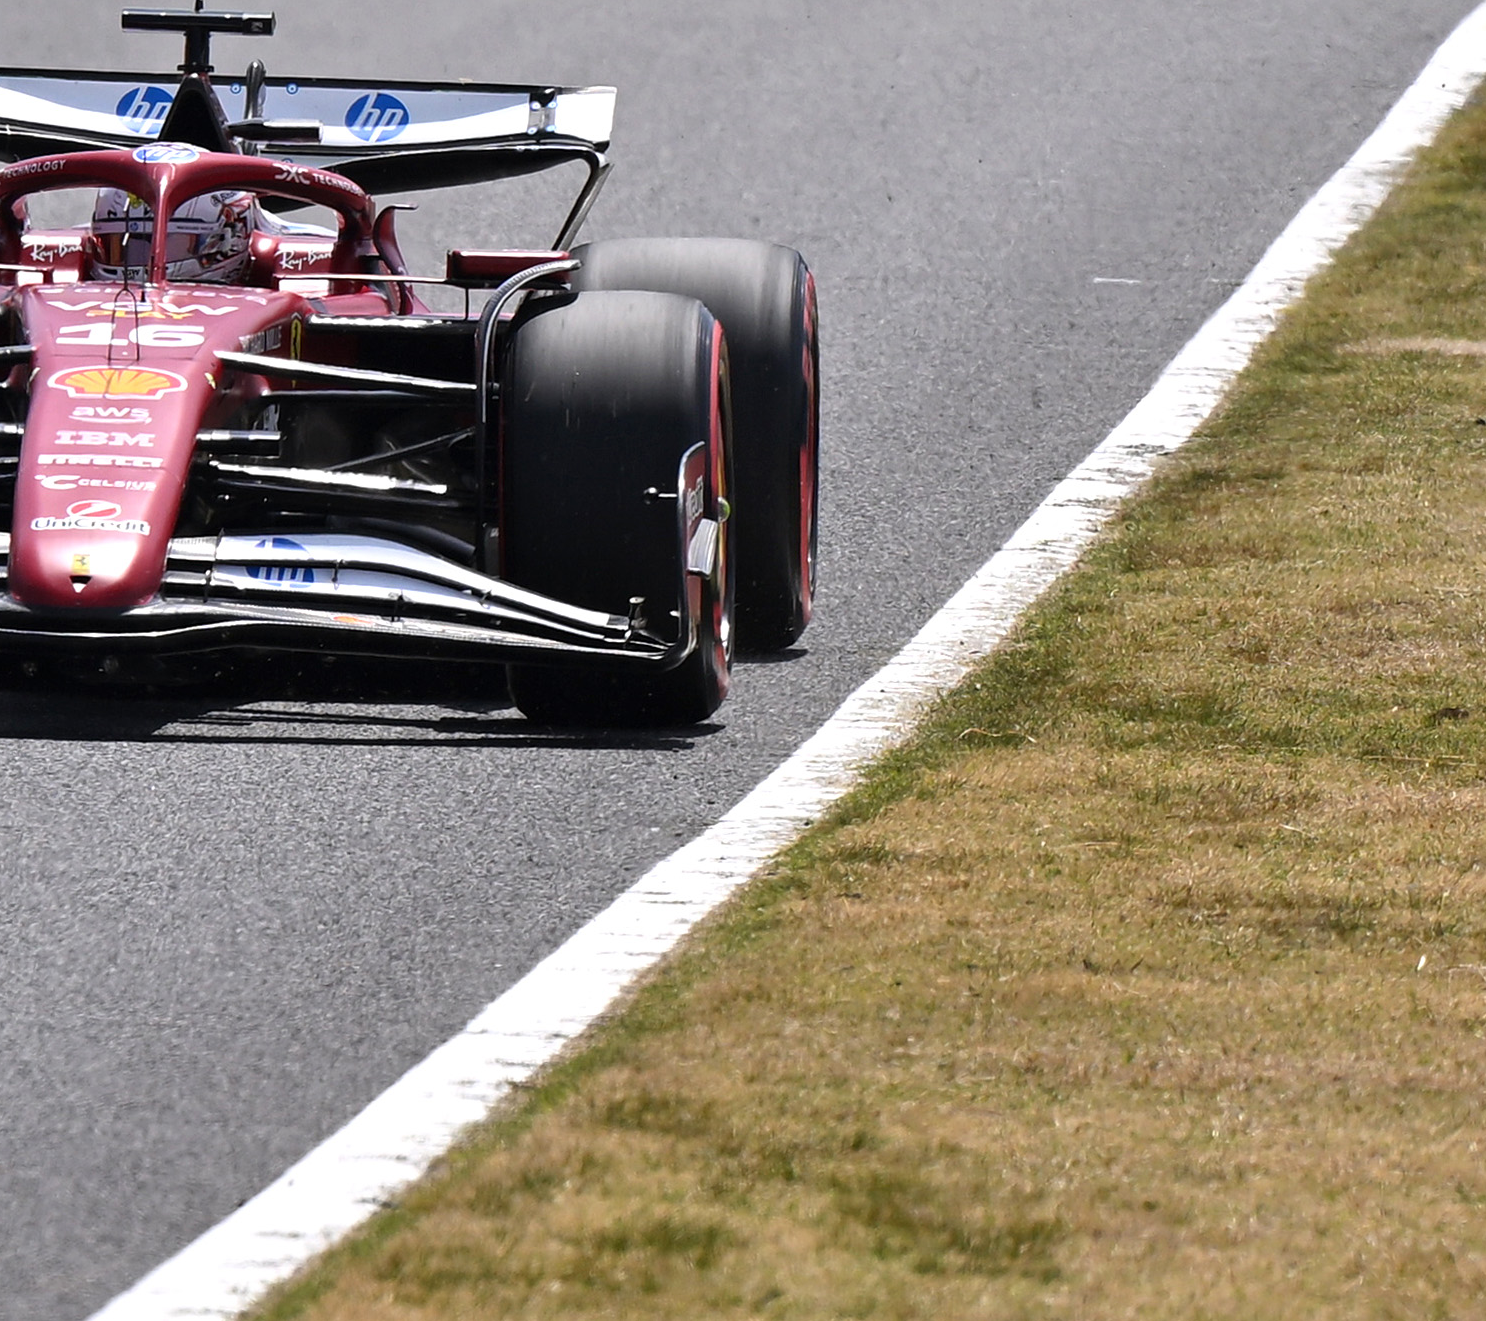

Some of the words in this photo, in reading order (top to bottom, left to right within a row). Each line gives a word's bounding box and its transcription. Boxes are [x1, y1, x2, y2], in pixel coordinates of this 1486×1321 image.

[352, 93, 406, 143] hp
[55, 322, 206, 348] 16
[71, 406, 150, 419] aws
[54, 430, 156, 447] IBM
[31, 517, 151, 536] UniCredit
